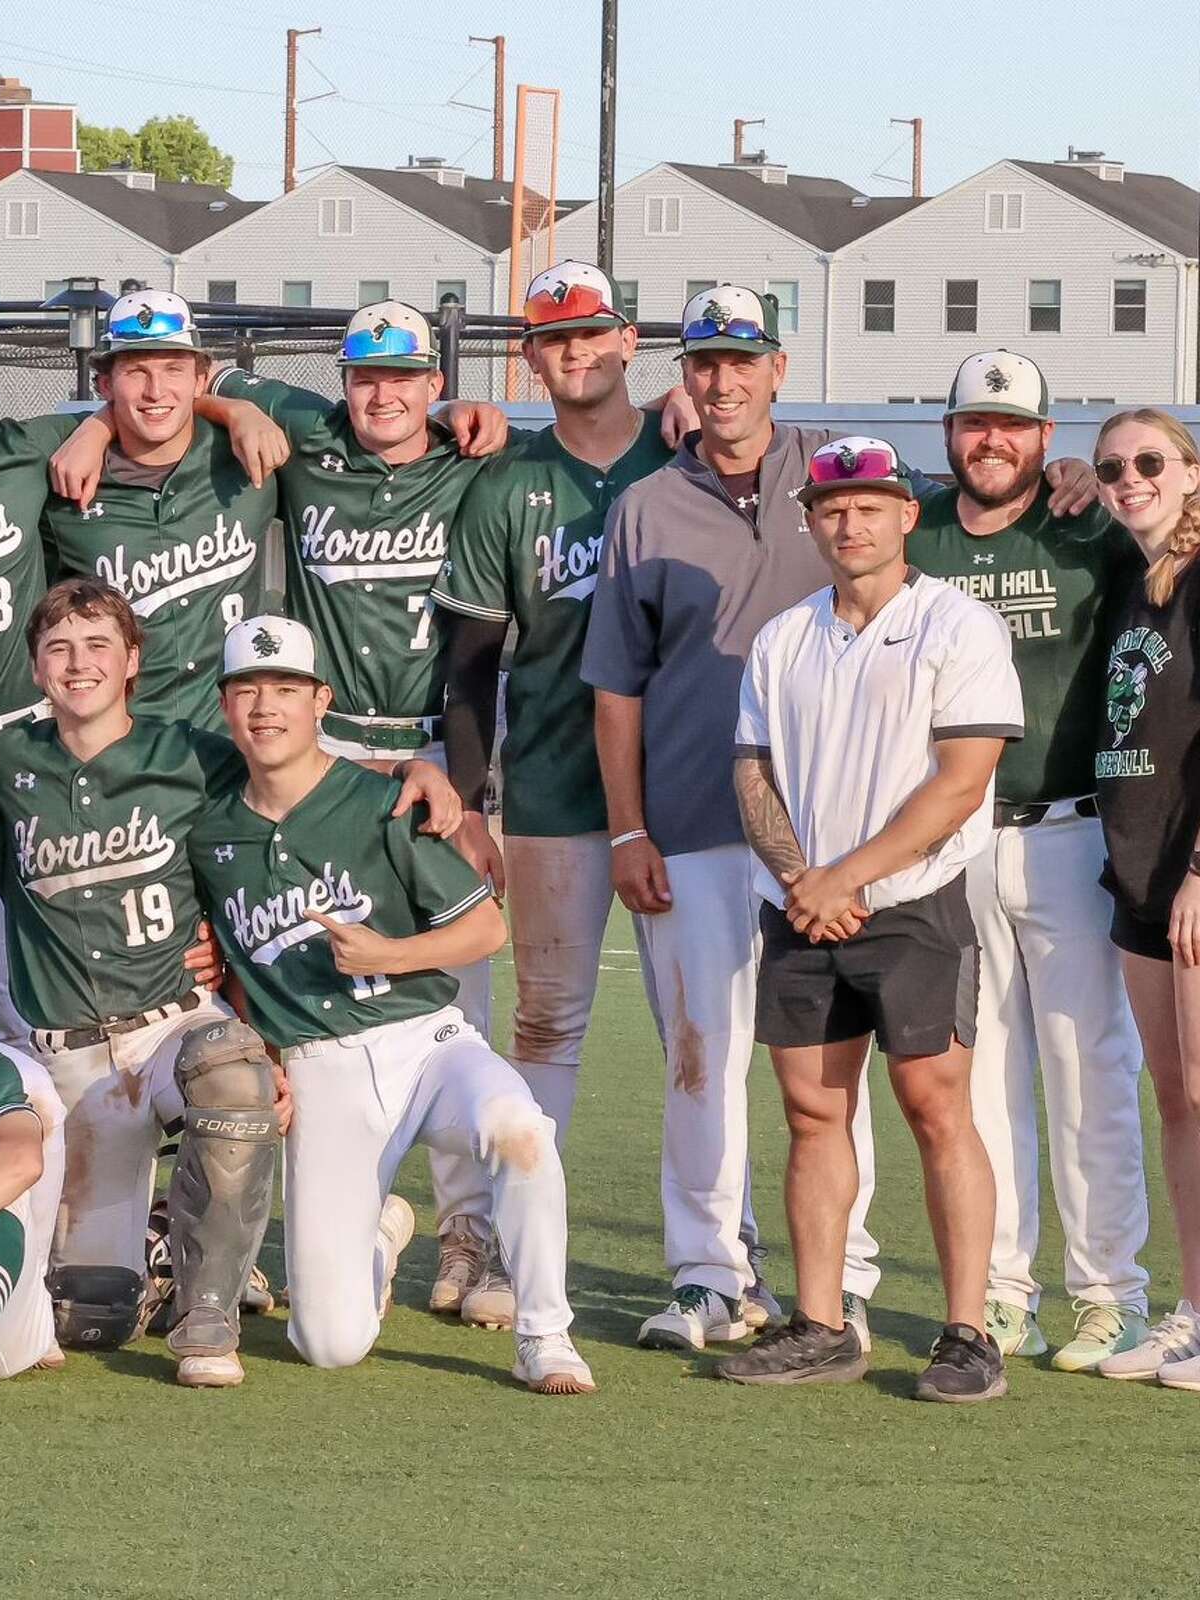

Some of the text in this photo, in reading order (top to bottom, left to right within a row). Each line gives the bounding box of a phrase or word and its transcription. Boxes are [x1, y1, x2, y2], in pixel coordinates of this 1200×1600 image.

[301, 504, 446, 562] Hornets
[1001, 569, 1057, 597] HALL
[407, 595, 435, 650] 7
[14, 806, 170, 877] Hornets
[121, 883, 175, 947] 19
[224, 862, 363, 952] Hornets
